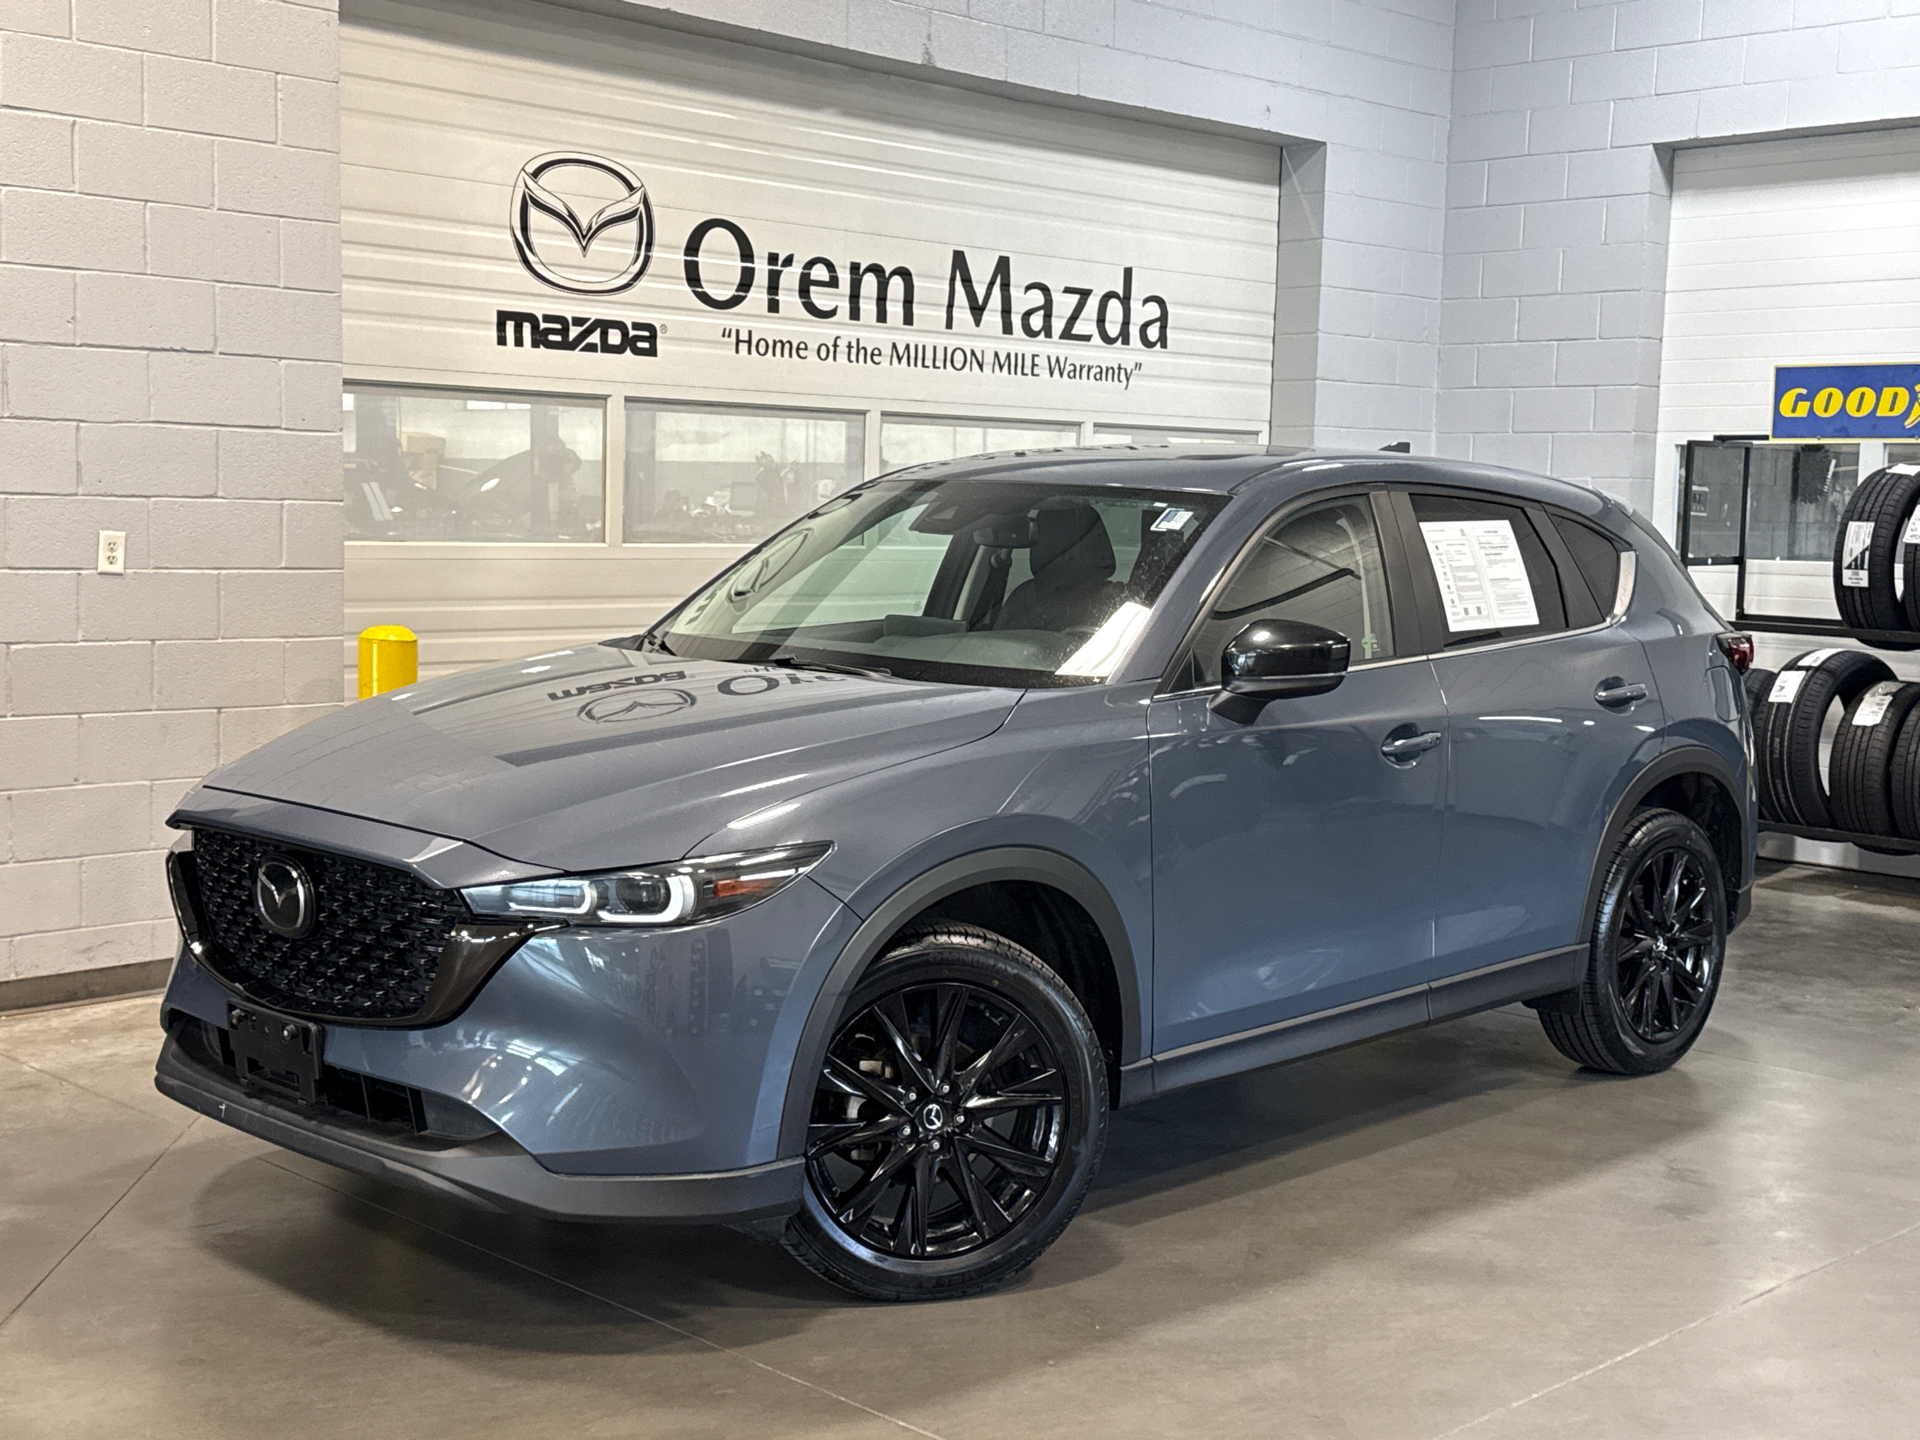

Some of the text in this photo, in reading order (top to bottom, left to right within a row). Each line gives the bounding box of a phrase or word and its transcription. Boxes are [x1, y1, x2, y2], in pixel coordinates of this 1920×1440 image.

[683, 218, 1169, 350] Orem Mazda
[721, 327, 808, 360] “Home
[816, 336, 841, 362] of
[846, 338, 882, 365] the
[889, 341, 985, 373] MILLION
[992, 350, 1040, 377] MILE
